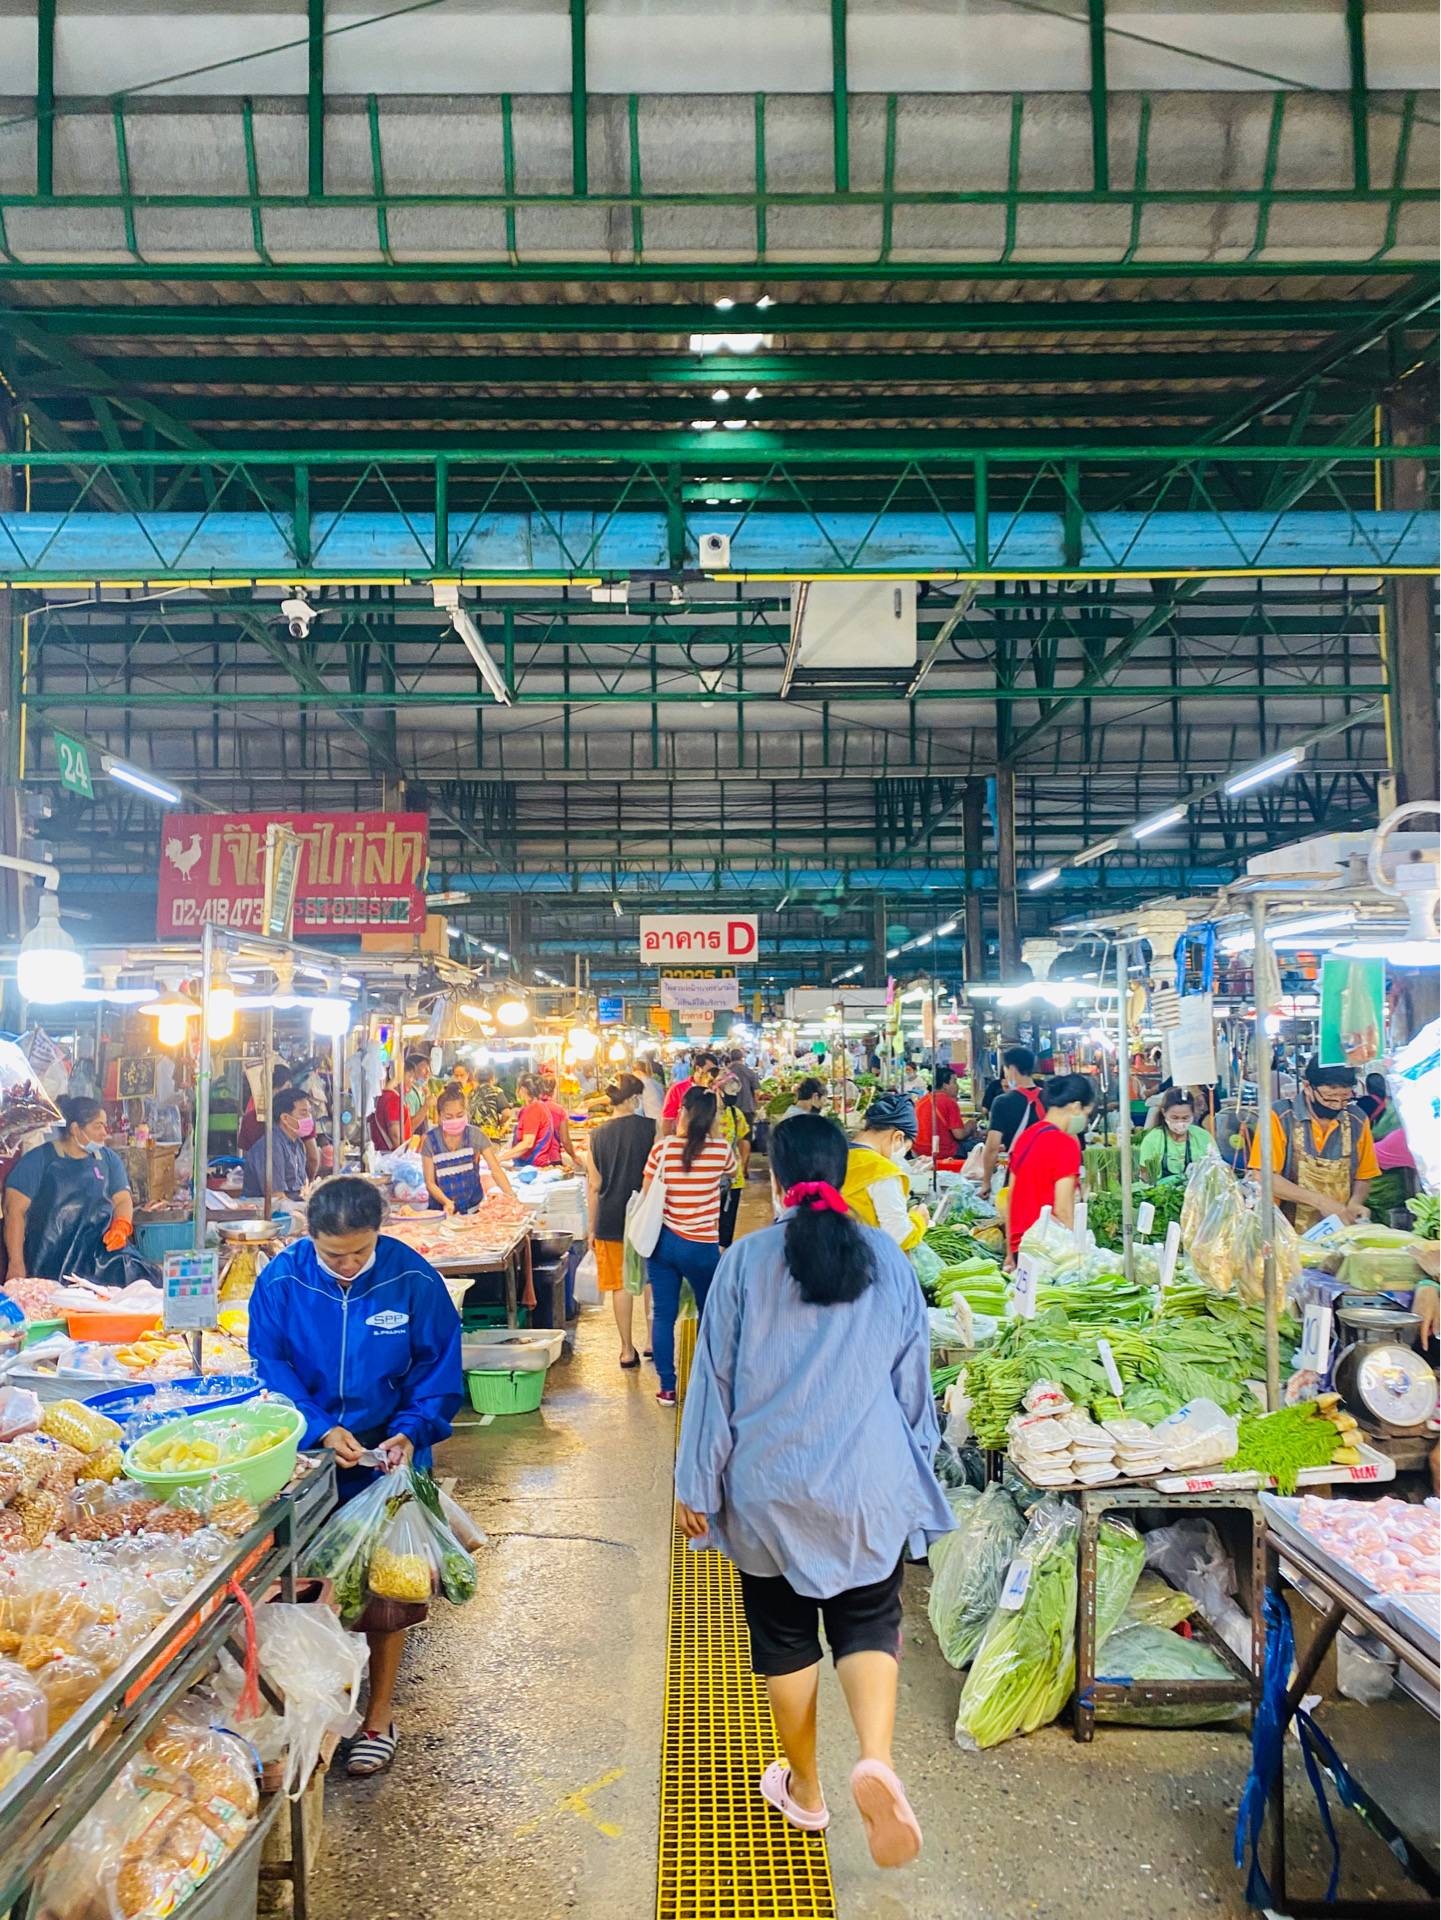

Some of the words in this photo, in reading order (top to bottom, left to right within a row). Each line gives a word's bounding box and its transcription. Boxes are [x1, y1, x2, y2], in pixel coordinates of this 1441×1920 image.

[61, 743, 88, 790] 24
[644, 930, 721, 950] อาคาร
[727, 921, 756, 955] D
